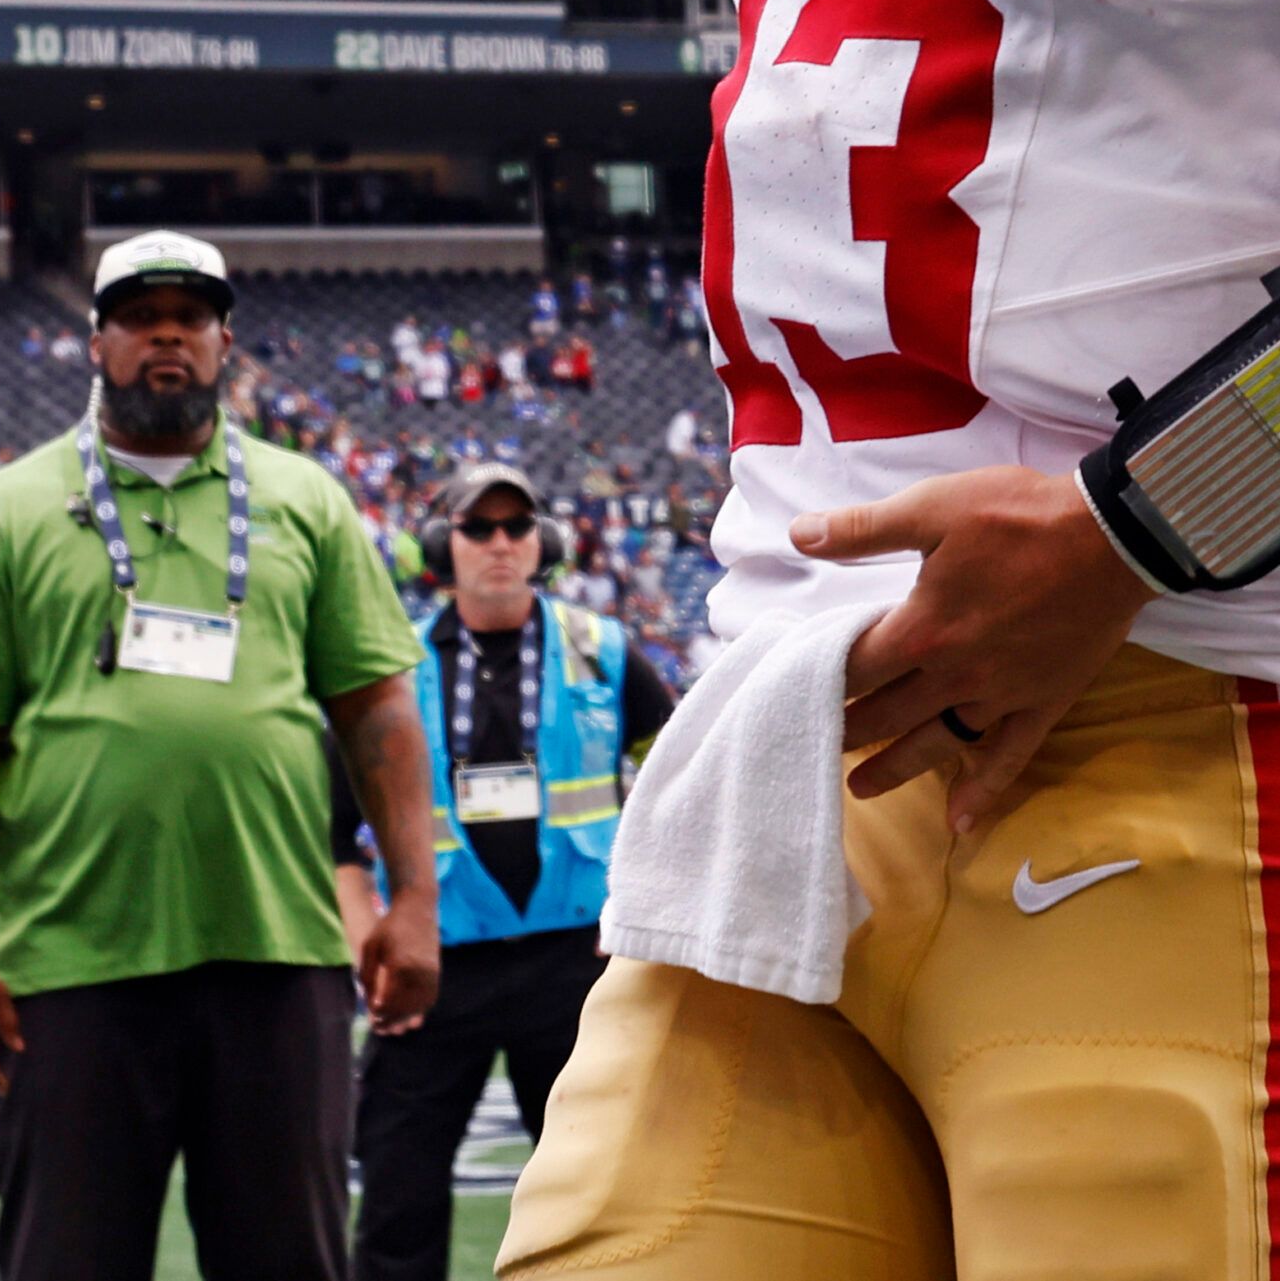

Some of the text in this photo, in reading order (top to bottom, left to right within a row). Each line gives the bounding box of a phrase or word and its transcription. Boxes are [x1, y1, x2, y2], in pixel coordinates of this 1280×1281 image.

[15, 25, 61, 64] 10
[64, 27, 118, 66] JIM
[122, 29, 193, 68] ZORN
[334, 32, 610, 72] 22 DAVE BROWN 76-86
